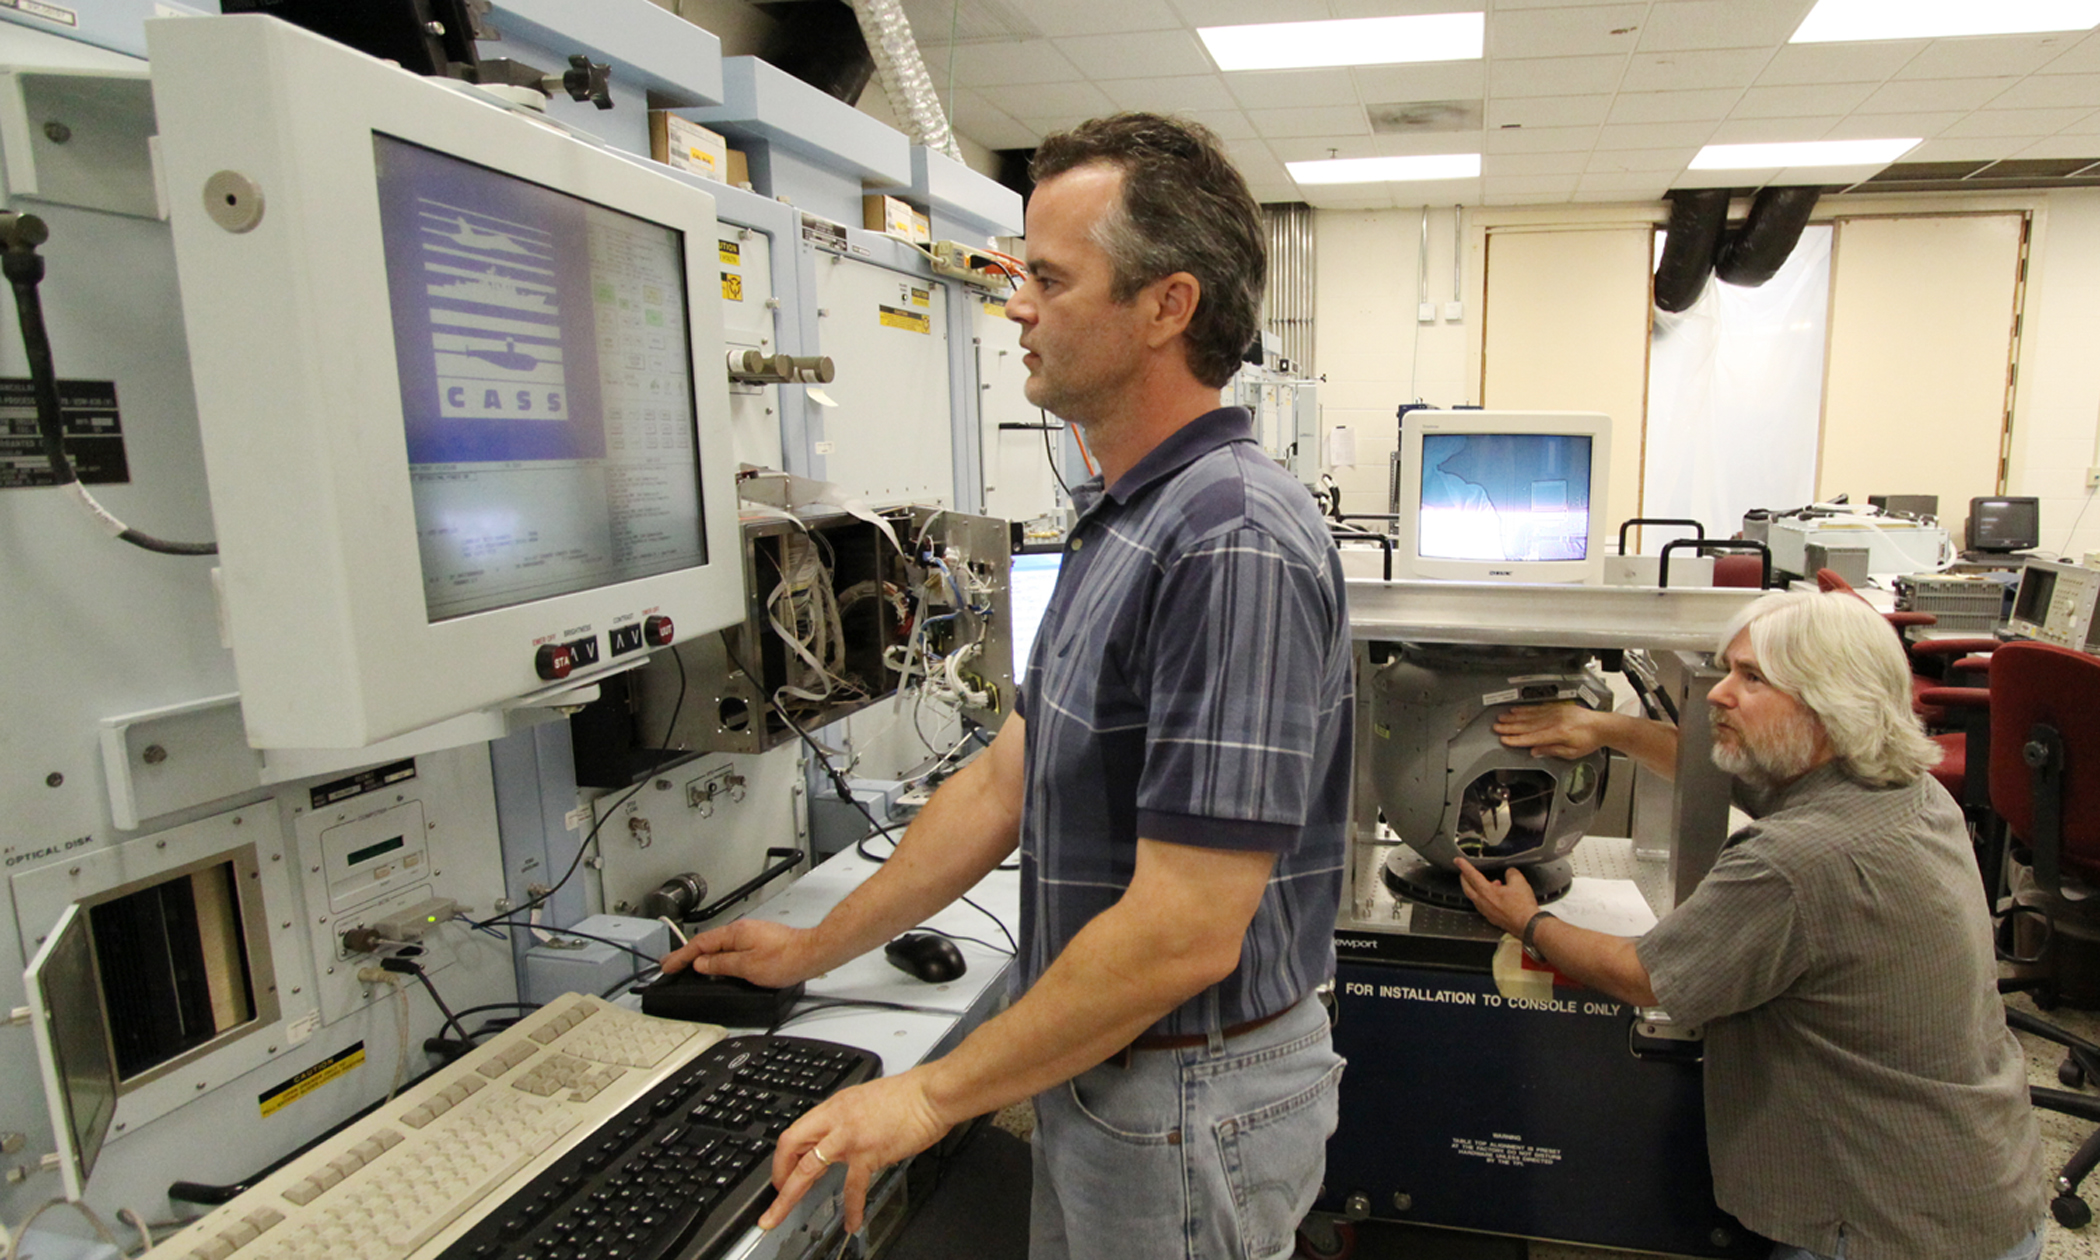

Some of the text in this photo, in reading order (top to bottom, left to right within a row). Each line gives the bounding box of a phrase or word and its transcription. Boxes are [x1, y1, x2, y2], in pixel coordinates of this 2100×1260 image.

[719, 242, 738, 254] UTION
[447, 386, 561, 412] CASS
[563, 624, 592, 637] BRIGHTNESS
[554, 655, 571, 669] STA
[5, 835, 93, 867] OPTICAL DISK
[1334, 938, 1378, 949] ewport
[1345, 982, 1622, 1017] FOR INSTALLATION TO CONSOLE ONLY
[293, 1057, 334, 1083] CAUTION
[1492, 1132, 1522, 1141] WARNING
